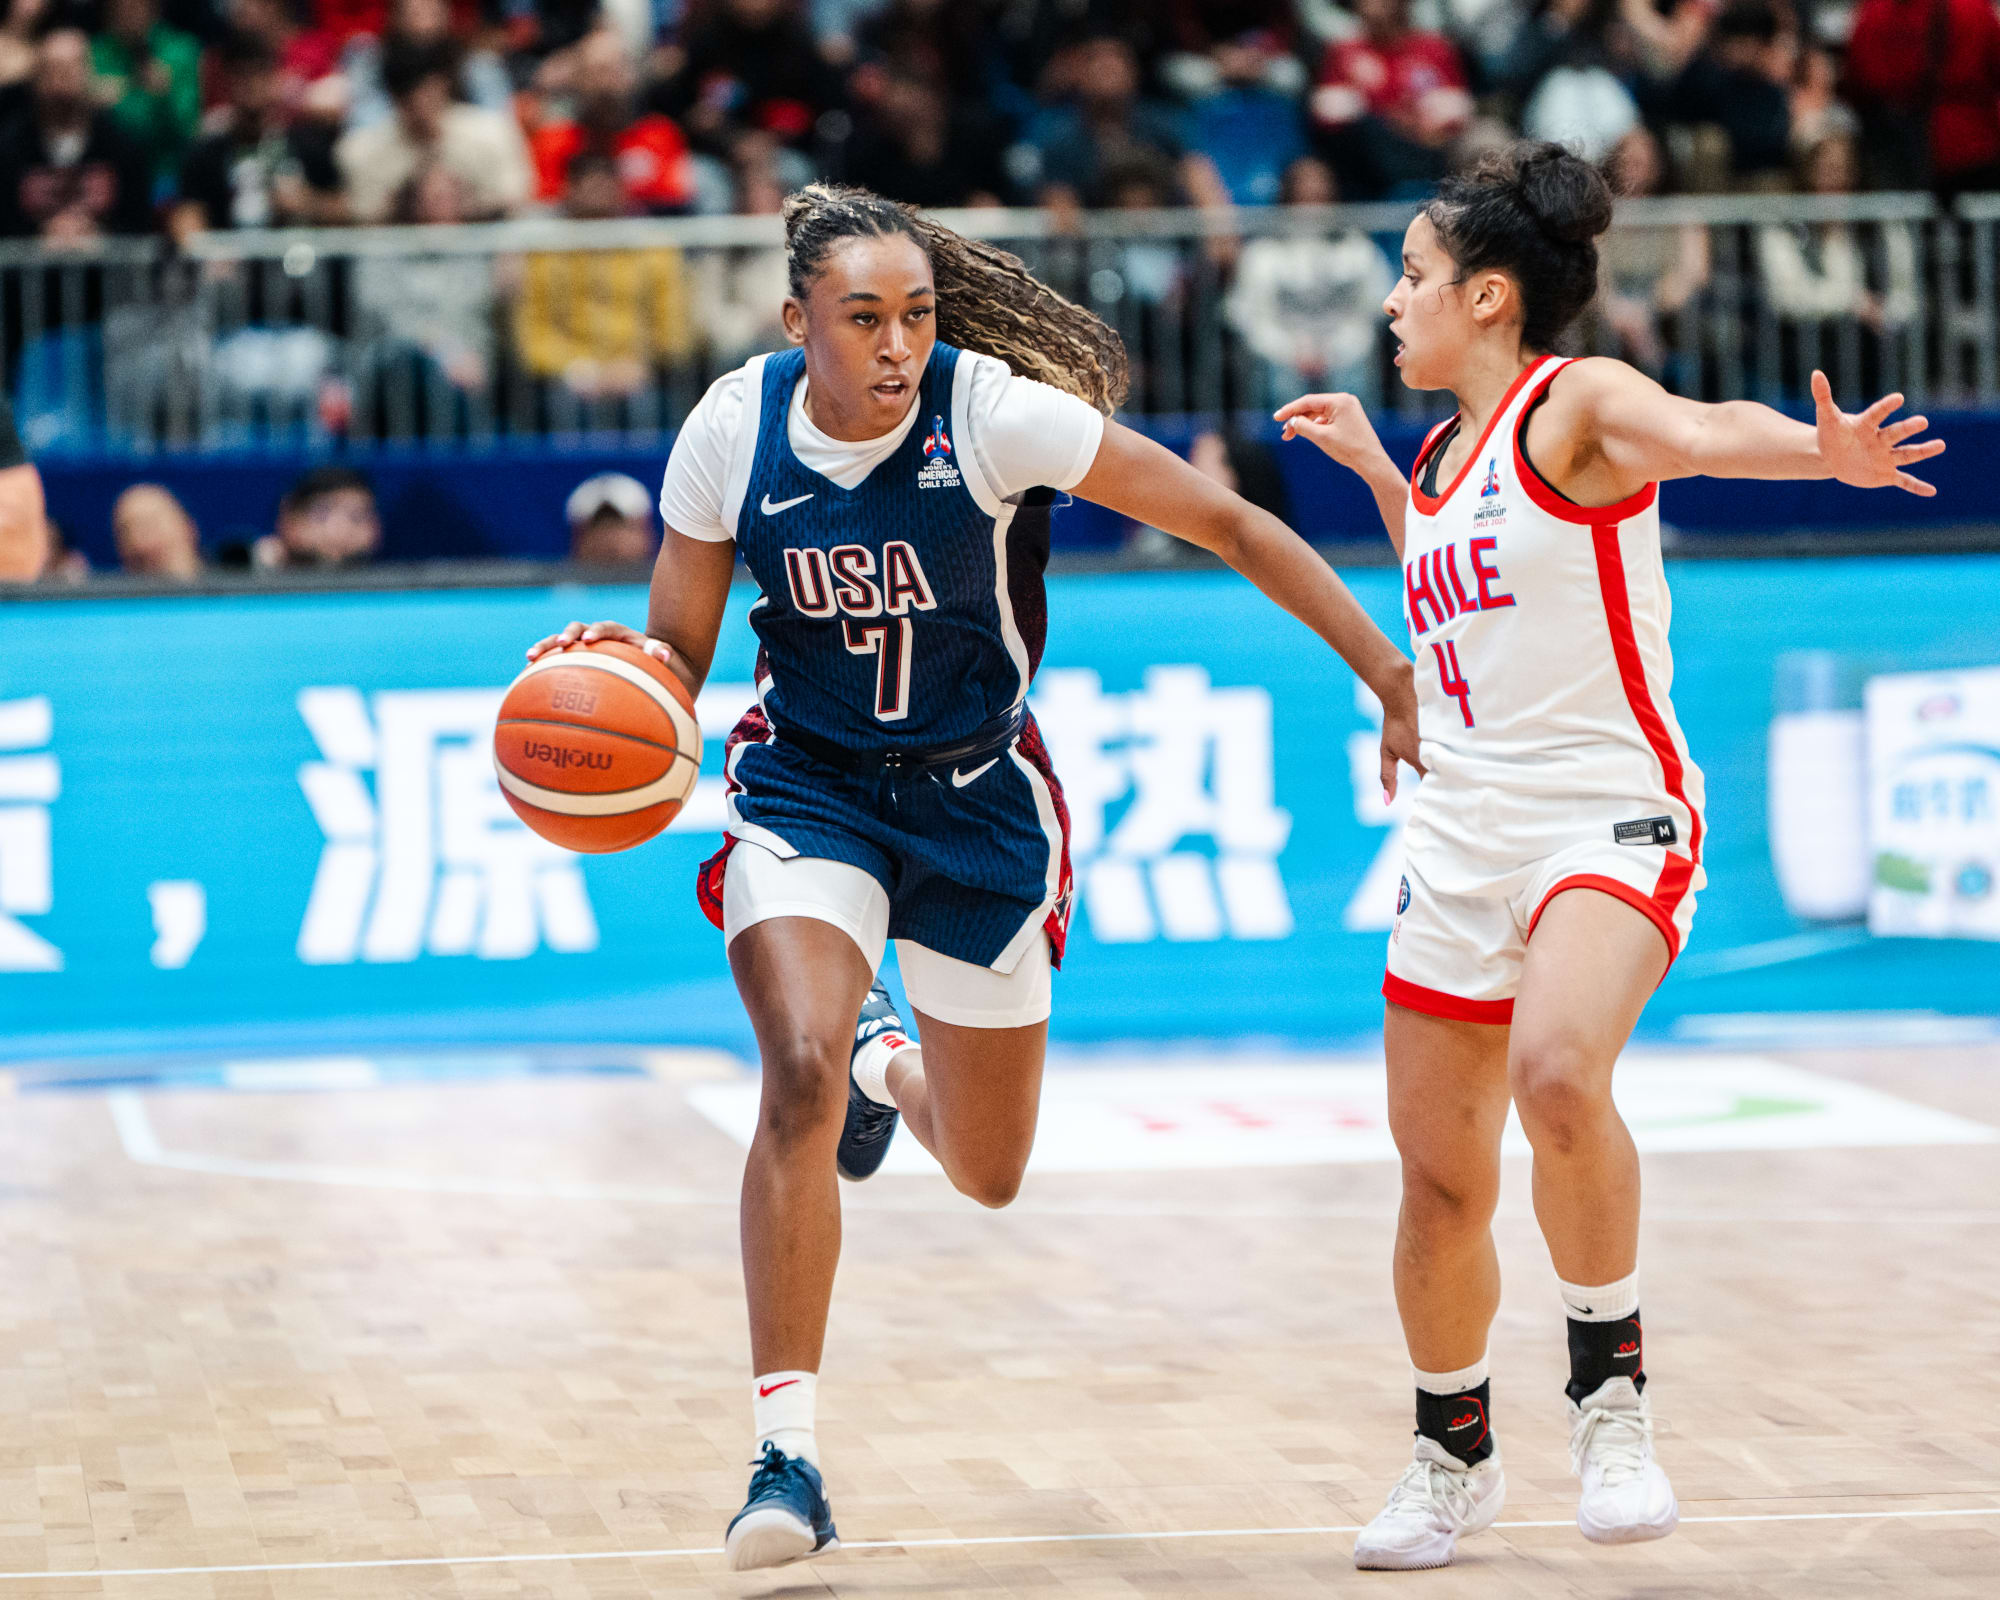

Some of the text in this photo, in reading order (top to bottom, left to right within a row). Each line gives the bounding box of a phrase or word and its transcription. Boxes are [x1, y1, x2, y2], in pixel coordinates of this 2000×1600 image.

[918, 469, 960, 481] AMERICUP
[918, 479, 961, 489] CHILE 2025
[1473, 507, 1507, 521] AMERICUP
[783, 541, 938, 618] USA
[1404, 536, 1517, 636] HILE
[842, 617, 913, 722] 7
[1430, 640, 1475, 728] 4
[551, 689, 598, 715] FIBA
[523, 740, 614, 770] molten
[1658, 825, 1671, 838] M
